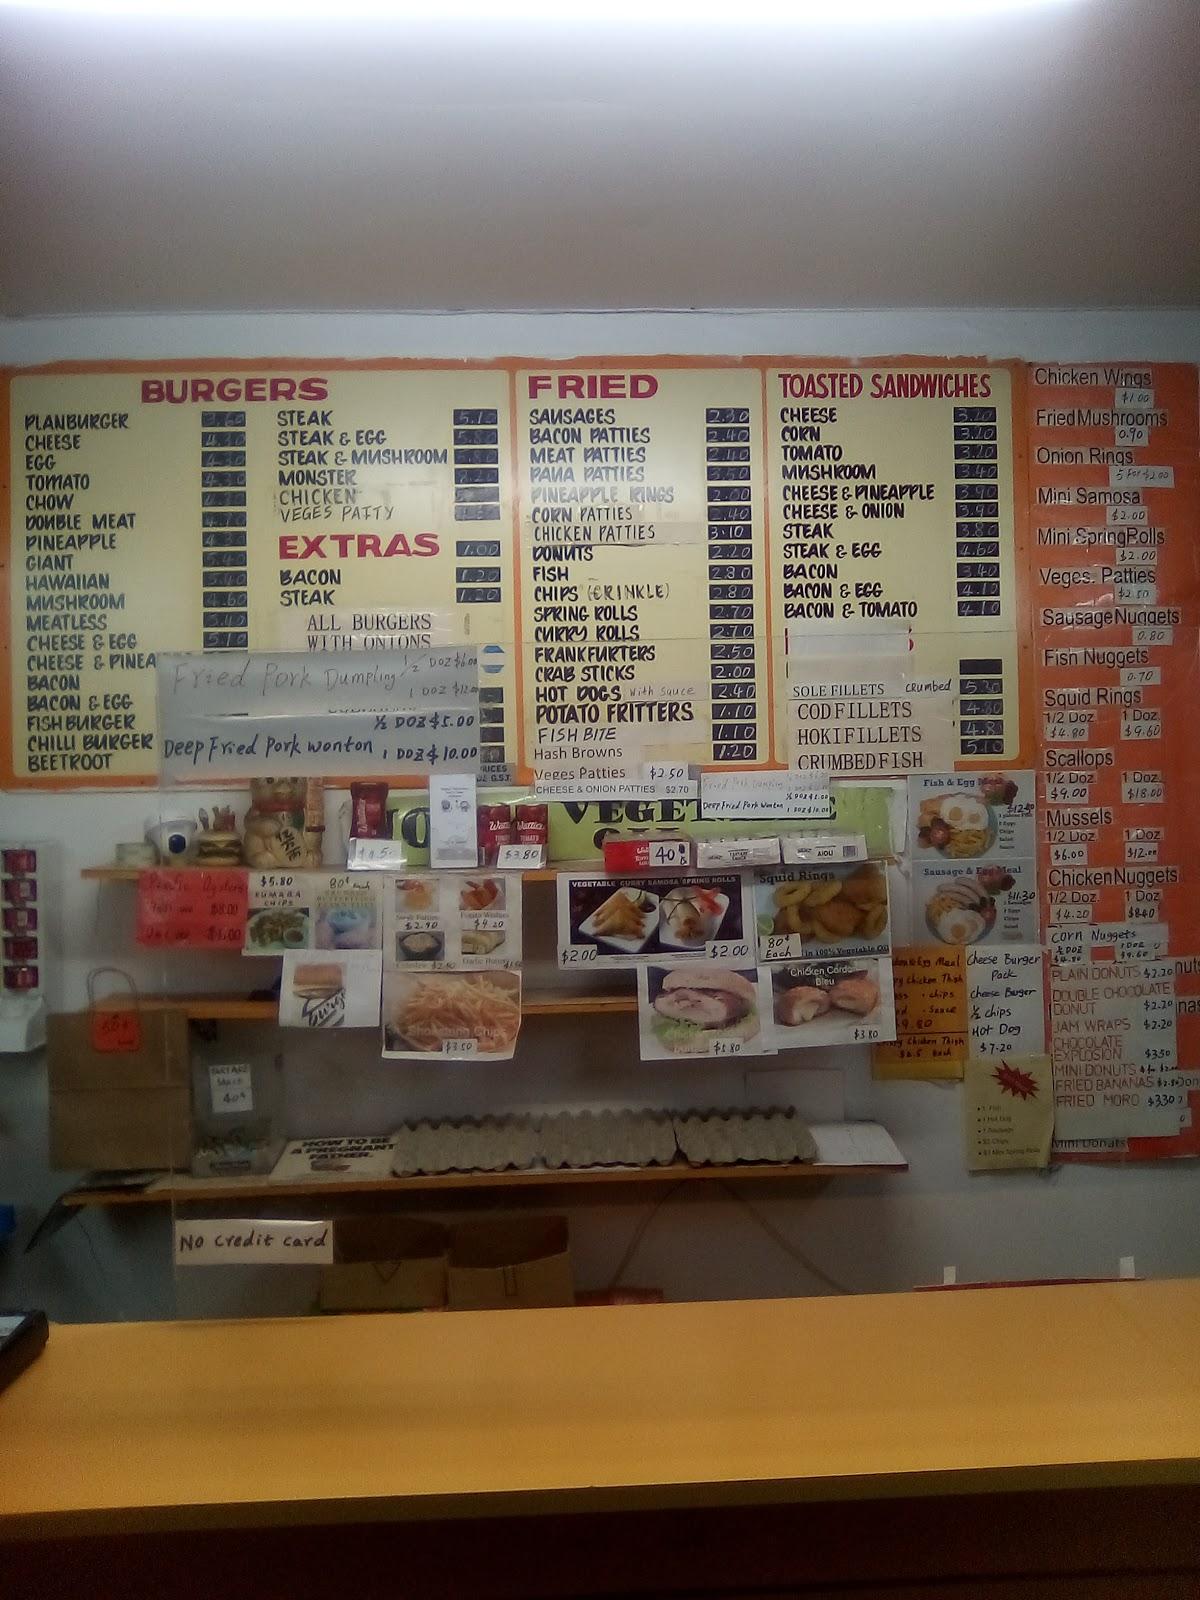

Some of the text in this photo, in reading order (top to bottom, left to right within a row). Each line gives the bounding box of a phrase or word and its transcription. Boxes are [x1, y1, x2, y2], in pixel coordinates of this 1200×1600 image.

[1035, 368, 1151, 387] Chicken Wings
[141, 378, 328, 404] BURGERS
[528, 375, 658, 399] FRIED
[778, 373, 991, 399] TOASTED SANDWICHES
[277, 410, 333, 426] STEAK
[529, 408, 616, 425] SAUSAGES
[780, 407, 837, 423] CHEESE
[25, 434, 81, 450] CHEESE
[278, 429, 387, 446] STEAK EGG
[530, 427, 650, 444] BACON PATTIES
[782, 426, 820, 442] CORN
[1119, 428, 1143, 442] 0.90
[278, 448, 447, 466] STEAK MUSHROOM
[530, 447, 646, 464] MEAT PATTIES
[782, 445, 843, 461] TOMATO
[1037, 447, 1133, 466] Onion Rings
[26, 455, 55, 470] EGG
[278, 469, 357, 486] MONSTER
[584, 466, 644, 482] PATTIES
[782, 464, 876, 480] MUSHROOM
[25, 474, 89, 491] TOMATO
[280, 489, 356, 506] CHICKEN
[531, 486, 674, 504] PINEAPPLE RINGS
[783, 484, 935, 501] CHEESE PINEAPPLE
[1038, 488, 1140, 504] Mini Samosa
[26, 494, 74, 510] CHOW
[532, 506, 632, 523] CORN PATTIES
[783, 503, 904, 520] CHEESE ONION
[1112, 509, 1145, 521] $2.00
[92, 513, 136, 529] MEAT
[535, 525, 655, 542] CHICKEN PATTIES
[783, 523, 833, 539] STEAK
[1038, 528, 1070, 544] Mini
[26, 534, 116, 550] PINEAPPLE
[279, 533, 440, 559] EXTRAS
[783, 542, 881, 558] STEAK EGG
[26, 555, 73, 571] GIANT
[1120, 551, 1156, 561] $2.00
[280, 569, 341, 585] BACON
[533, 566, 568, 582] FISH
[784, 564, 837, 579] BACON
[1102, 567, 1155, 584] Patties
[25, 573, 110, 590] HAWAIIAN
[280, 589, 335, 607] STEAK
[535, 585, 578, 602] CHIPS
[784, 583, 883, 598] BACON EGG
[27, 593, 125, 611] MUSHROOM
[784, 601, 917, 619] BACON TOMATO
[534, 605, 638, 622] SPRING ROLLS
[27, 614, 107, 631] MEATLESS
[307, 613, 432, 631] ALL BURGERS
[535, 625, 639, 642] CURRY ROLLS
[1137, 631, 1164, 641] 0.80
[27, 633, 137, 651] CHEESE EGG
[307, 635, 352, 650] WITH
[535, 645, 655, 663] FRANKFURTERS
[1044, 648, 1148, 668] Fish Nuggets
[27, 654, 83, 671] CHEESE
[173, 659, 397, 696] Fried Pork Dumpling
[535, 665, 635, 682] CRAB STICKS
[1127, 671, 1153, 681] 0.70
[27, 675, 80, 691] BACON
[793, 684, 884, 698] SOLE FILLETS
[536, 685, 622, 702] HOT DOGS
[1045, 688, 1141, 709] Squid Rings
[27, 694, 132, 712] BACON EGG
[395, 712, 475, 730] DOZ $5.00
[536, 702, 694, 724] POTATO FRITTERS
[538, 727, 616, 744] FISH BITE
[1125, 725, 1160, 737] $9.60
[28, 734, 153, 752] CHILLI BURGER
[164, 739, 204, 765] Deep
[209, 733, 258, 762] Fried
[266, 733, 301, 758] Pork
[397, 748, 423, 761] DOZ
[534, 748, 622, 760] Hash Browns
[1046, 750, 1113, 768] Scallops
[28, 754, 112, 772] BEETROOT
[580, 767, 625, 780] Patties
[536, 784, 655, 794] CHEESE ONION PATTIES
[923, 778, 944, 787] Fish
[957, 778, 975, 788] Egg
[1051, 788, 1087, 800] $9.00
[1127, 788, 1162, 800] $18.00
[1047, 809, 1112, 827] Mussels
[1054, 850, 1084, 860] $6.00
[760, 871, 835, 884] Squid Rings
[924, 868, 963, 877] Sausage
[260, 876, 293, 887] $5.80
[1056, 909, 1089, 920] $4.20
[1092, 929, 1136, 942] Nuggets
[561, 949, 597, 964] $2.00
[710, 946, 748, 958] $2.00
[967, 951, 1040, 967] Cheese Burger
[790, 968, 825, 976] Chicken
[1000, 1024, 1021, 1036] Dog
[980, 1043, 1012, 1055] $7.20
[305, 1144, 398, 1154] PREGNANT
[180, 1229, 328, 1251] No credit card
